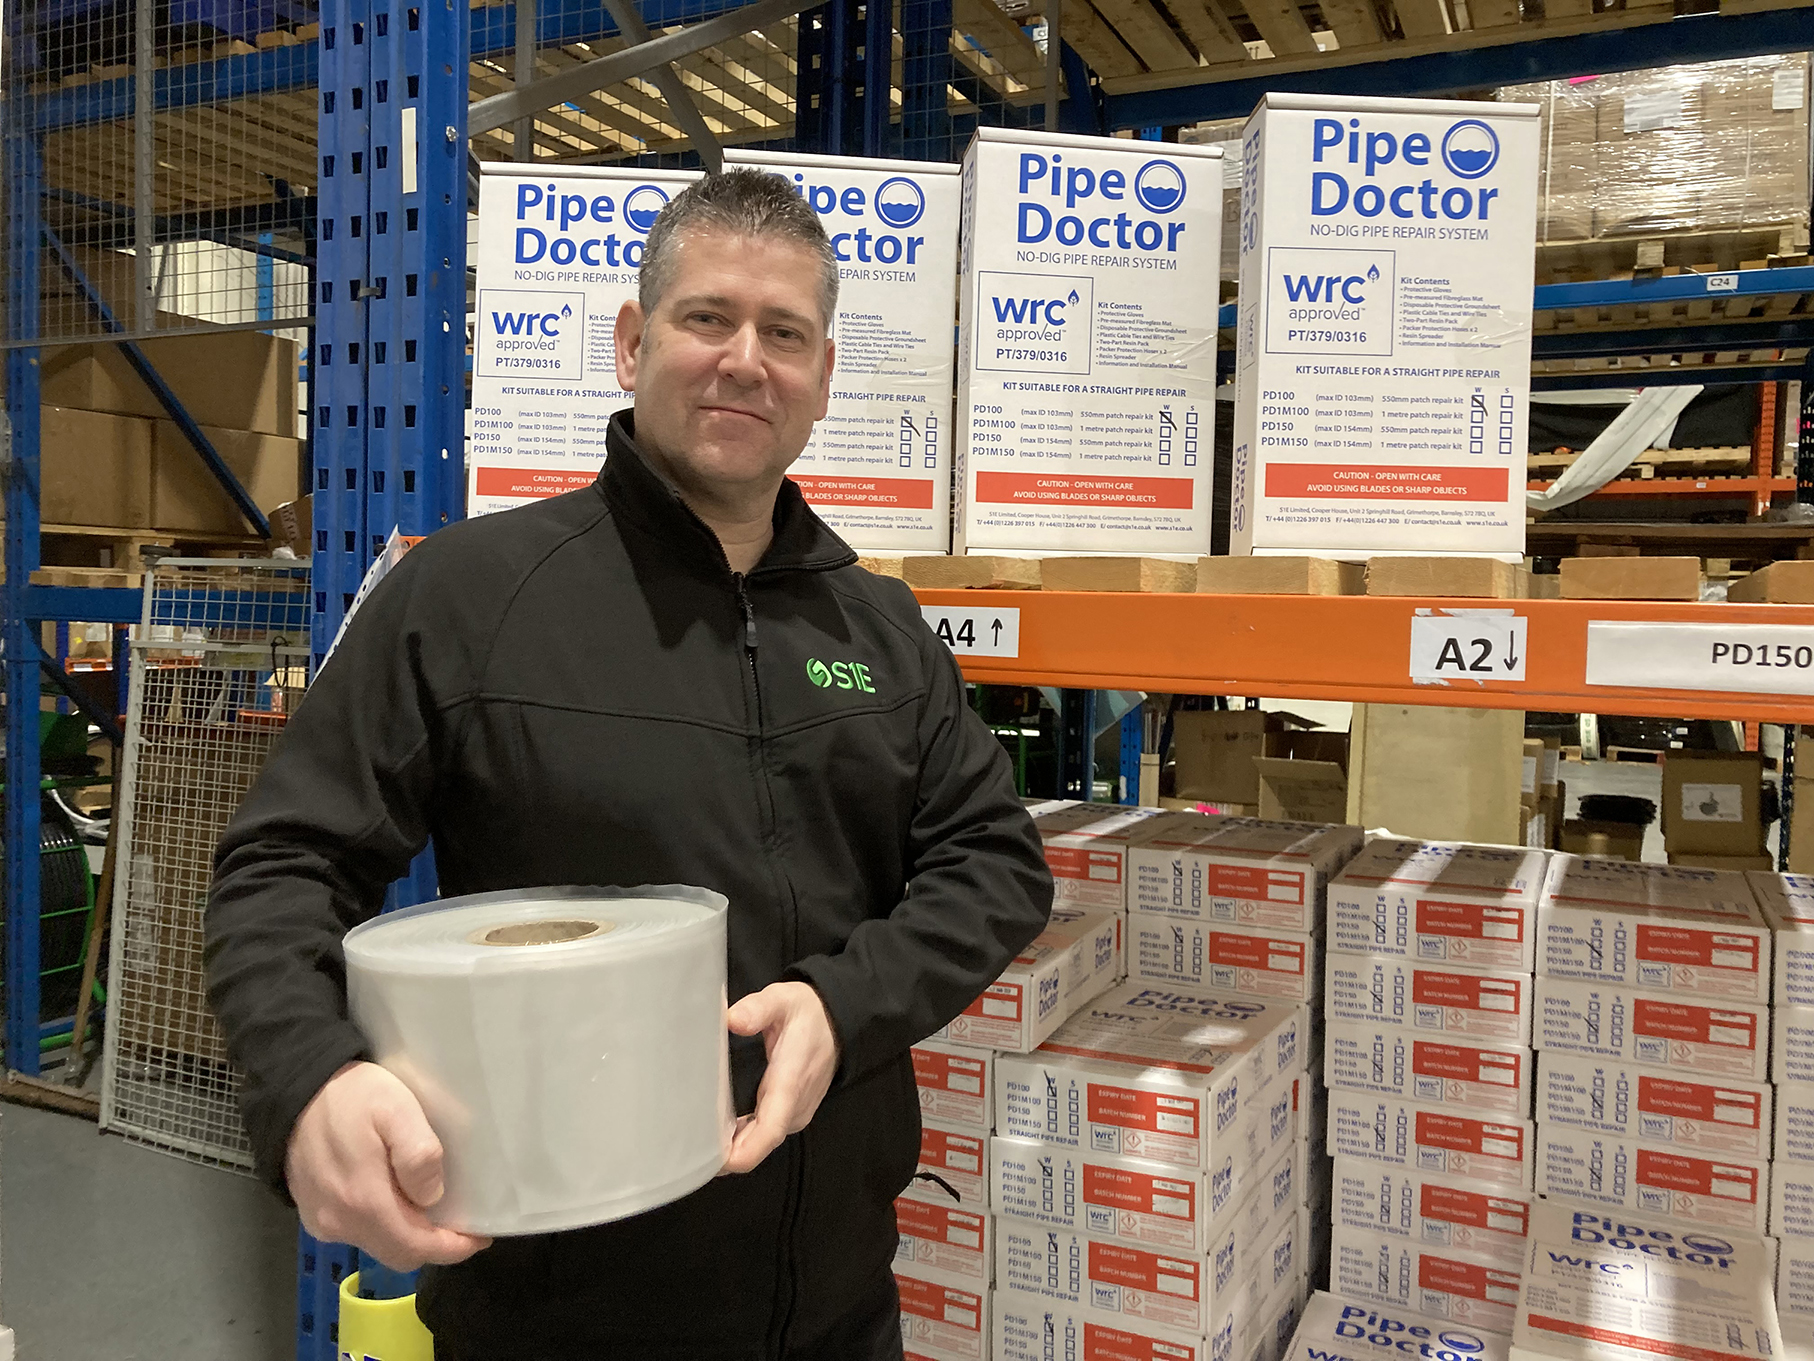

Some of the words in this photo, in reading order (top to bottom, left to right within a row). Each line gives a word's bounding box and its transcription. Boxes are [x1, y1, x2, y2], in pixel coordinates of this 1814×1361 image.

[1312, 118, 1432, 176] Pipe
[1019, 153, 1126, 208] Pipe
[768, 174, 866, 216] ipe
[1311, 172, 1498, 220] Doctor
[516, 184, 615, 232] Pipe
[1018, 202, 1186, 252] Doctor
[1310, 224, 1358, 236] NO-DIG
[1362, 225, 1388, 237] PIPE
[1392, 226, 1435, 238] REPAIR
[1438, 227, 1488, 240] SYSTEM
[515, 228, 644, 267] Docto
[831, 228, 924, 264] ctor
[1017, 250, 1060, 263] NO-DIG
[1064, 253, 1087, 265] PIPE
[1091, 255, 1129, 267] REPAIR
[1132, 257, 1176, 269] SYSTEM
[514, 270, 554, 280] NO-DIG
[557, 271, 579, 282] PIPE
[582, 272, 617, 283] REPAIR
[873, 270, 915, 282] SYSTEM
[1414, 277, 1449, 285] Contents
[1283, 274, 1366, 304] wrc
[992, 297, 1066, 326] wrc
[1110, 302, 1142, 311] Contents
[492, 312, 560, 336] wrc
[1288, 330, 1366, 343] PT/379/0316
[996, 348, 1067, 362] PT/379/0316
[496, 358, 561, 369] PT/379/0316
[1296, 365, 1311, 373] KIT
[1313, 366, 1359, 374] SUITABLE
[1362, 367, 1380, 375] FOR
[1392, 368, 1440, 376] STRAIGHT
[1442, 369, 1463, 377] PIPE
[1466, 369, 1499, 378] REPAIR
[582, 390, 621, 398] STRAIGHT
[832, 390, 874, 400] STRAIGHT
[1019, 382, 1060, 391] SUITABLE
[1062, 384, 1079, 392] FOR
[1090, 385, 1133, 394] STRAIGHT
[1135, 387, 1153, 395] PIPE
[1155, 388, 1186, 396] REPAIR
[1263, 390, 1294, 400] PD100
[1316, 394, 1331, 402] (max
[1432, 396, 1453, 404] repair
[974, 404, 1002, 413] PD100
[1262, 406, 1308, 415] PD1M100
[474, 420, 513, 428] PD1M100
[973, 418, 1015, 428] PD1M100
[1262, 421, 1293, 430] PD150
[973, 432, 1001, 441] PD150
[1261, 436, 1307, 446] PD1M150
[474, 445, 512, 454] PD1M150
[972, 446, 1014, 456] PD1M150
[1375, 472, 1397, 481] OPEN
[804, 492, 831, 502] BLADES
[868, 494, 897, 503] OBJECTS
[936, 618, 976, 648] A4
[1436, 638, 1494, 672] A2
[1712, 642, 1812, 669] PD150
[1139, 990, 1218, 1004] Pipe
[1127, 997, 1258, 1020] Doctor
[1007, 1082, 1030, 1092] PD100
[1007, 1094, 1041, 1105] PD1M100
[1098, 1090, 1120, 1099] EXPIRY
[1121, 1092, 1136, 1101] DATE
[1008, 1106, 1030, 1116] PD150
[1098, 1108, 1115, 1116] BATCH
[1116, 1110, 1146, 1121] NUMBER
[1008, 1117, 1042, 1128] PD1M150
[1009, 1129, 1041, 1139] STRAIGHT
[1043, 1134, 1054, 1142] PIPE
[1055, 1136, 1078, 1146] REPAIR
[1572, 1212, 1674, 1242] Pipe
[1572, 1226, 1736, 1268] Doctor
[1548, 1251, 1620, 1274] wrc
[1342, 1306, 1431, 1339] Pipe
